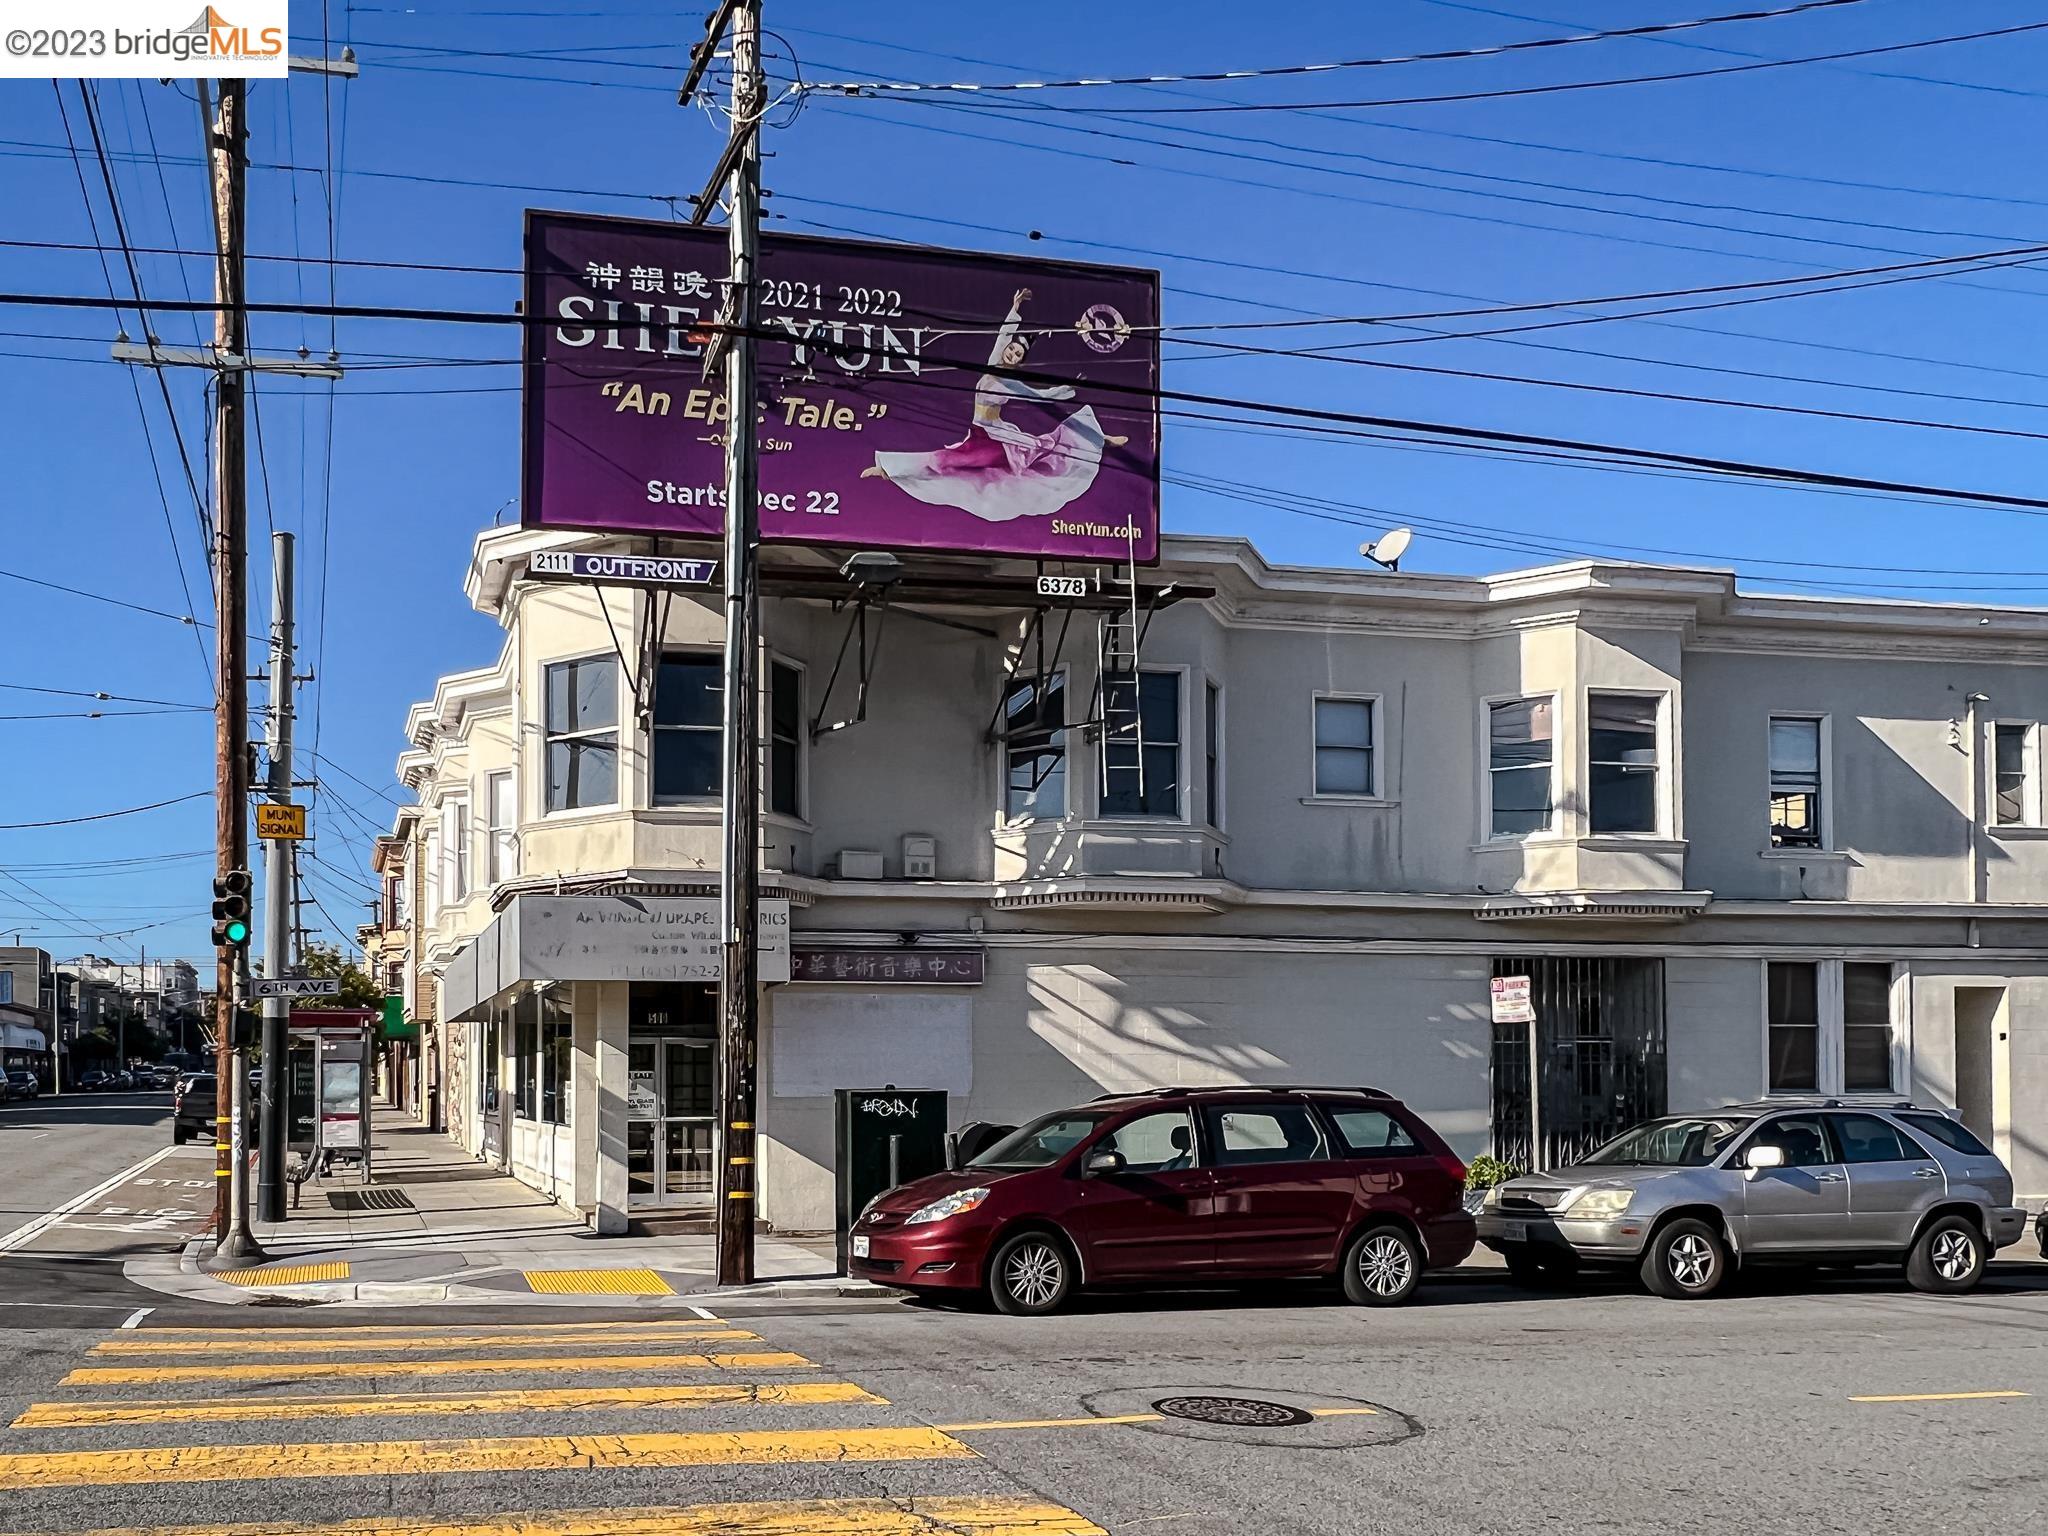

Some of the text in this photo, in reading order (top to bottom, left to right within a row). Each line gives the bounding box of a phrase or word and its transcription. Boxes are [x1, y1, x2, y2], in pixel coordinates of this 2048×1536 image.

[582, 261, 713, 299] 神韻晚
[761, 279, 903, 317] 2021 2022
[556, 296, 724, 358] SHE
[684, 388, 768, 426] Epc
[766, 438, 793, 451] Sun
[758, 489, 796, 512] ec
[805, 490, 840, 515] 22
[1051, 519, 1142, 539] ShenYun.com
[536, 553, 569, 570] 2111
[586, 557, 702, 580] OUTFRONT
[1039, 579, 1084, 595] 6378
[266, 809, 297, 821] MUNI
[260, 823, 303, 836] SIGNAL
[297, 980, 336, 995] AVE
